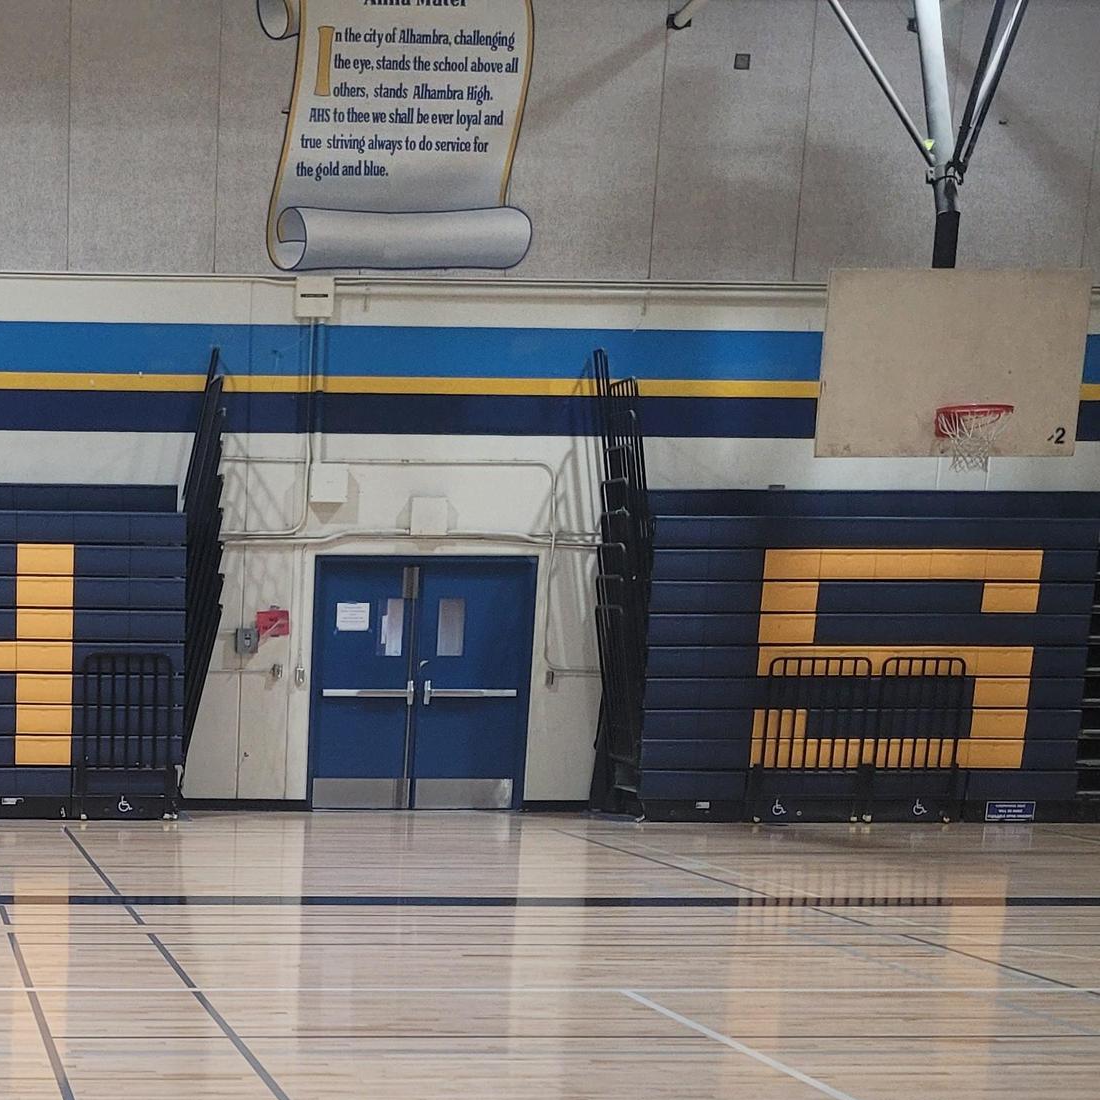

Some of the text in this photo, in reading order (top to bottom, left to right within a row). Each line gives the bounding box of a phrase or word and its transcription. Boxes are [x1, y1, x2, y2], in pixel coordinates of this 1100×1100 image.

[345, 27, 361, 43] the
[364, 28, 384, 48] city
[386, 27, 397, 43] of
[399, 28, 452, 47] Alhambra,
[454, 29, 515, 52] challenging
[334, 53, 519, 75] the eye, stands the school above all
[333, 82, 493, 106] others, stands Alhambra High.
[309, 107, 504, 132] AHS to thee we shall be ever loyal and
[301, 133, 489, 156] true striving always to do service for
[296, 160, 389, 181] the gold and blue.
